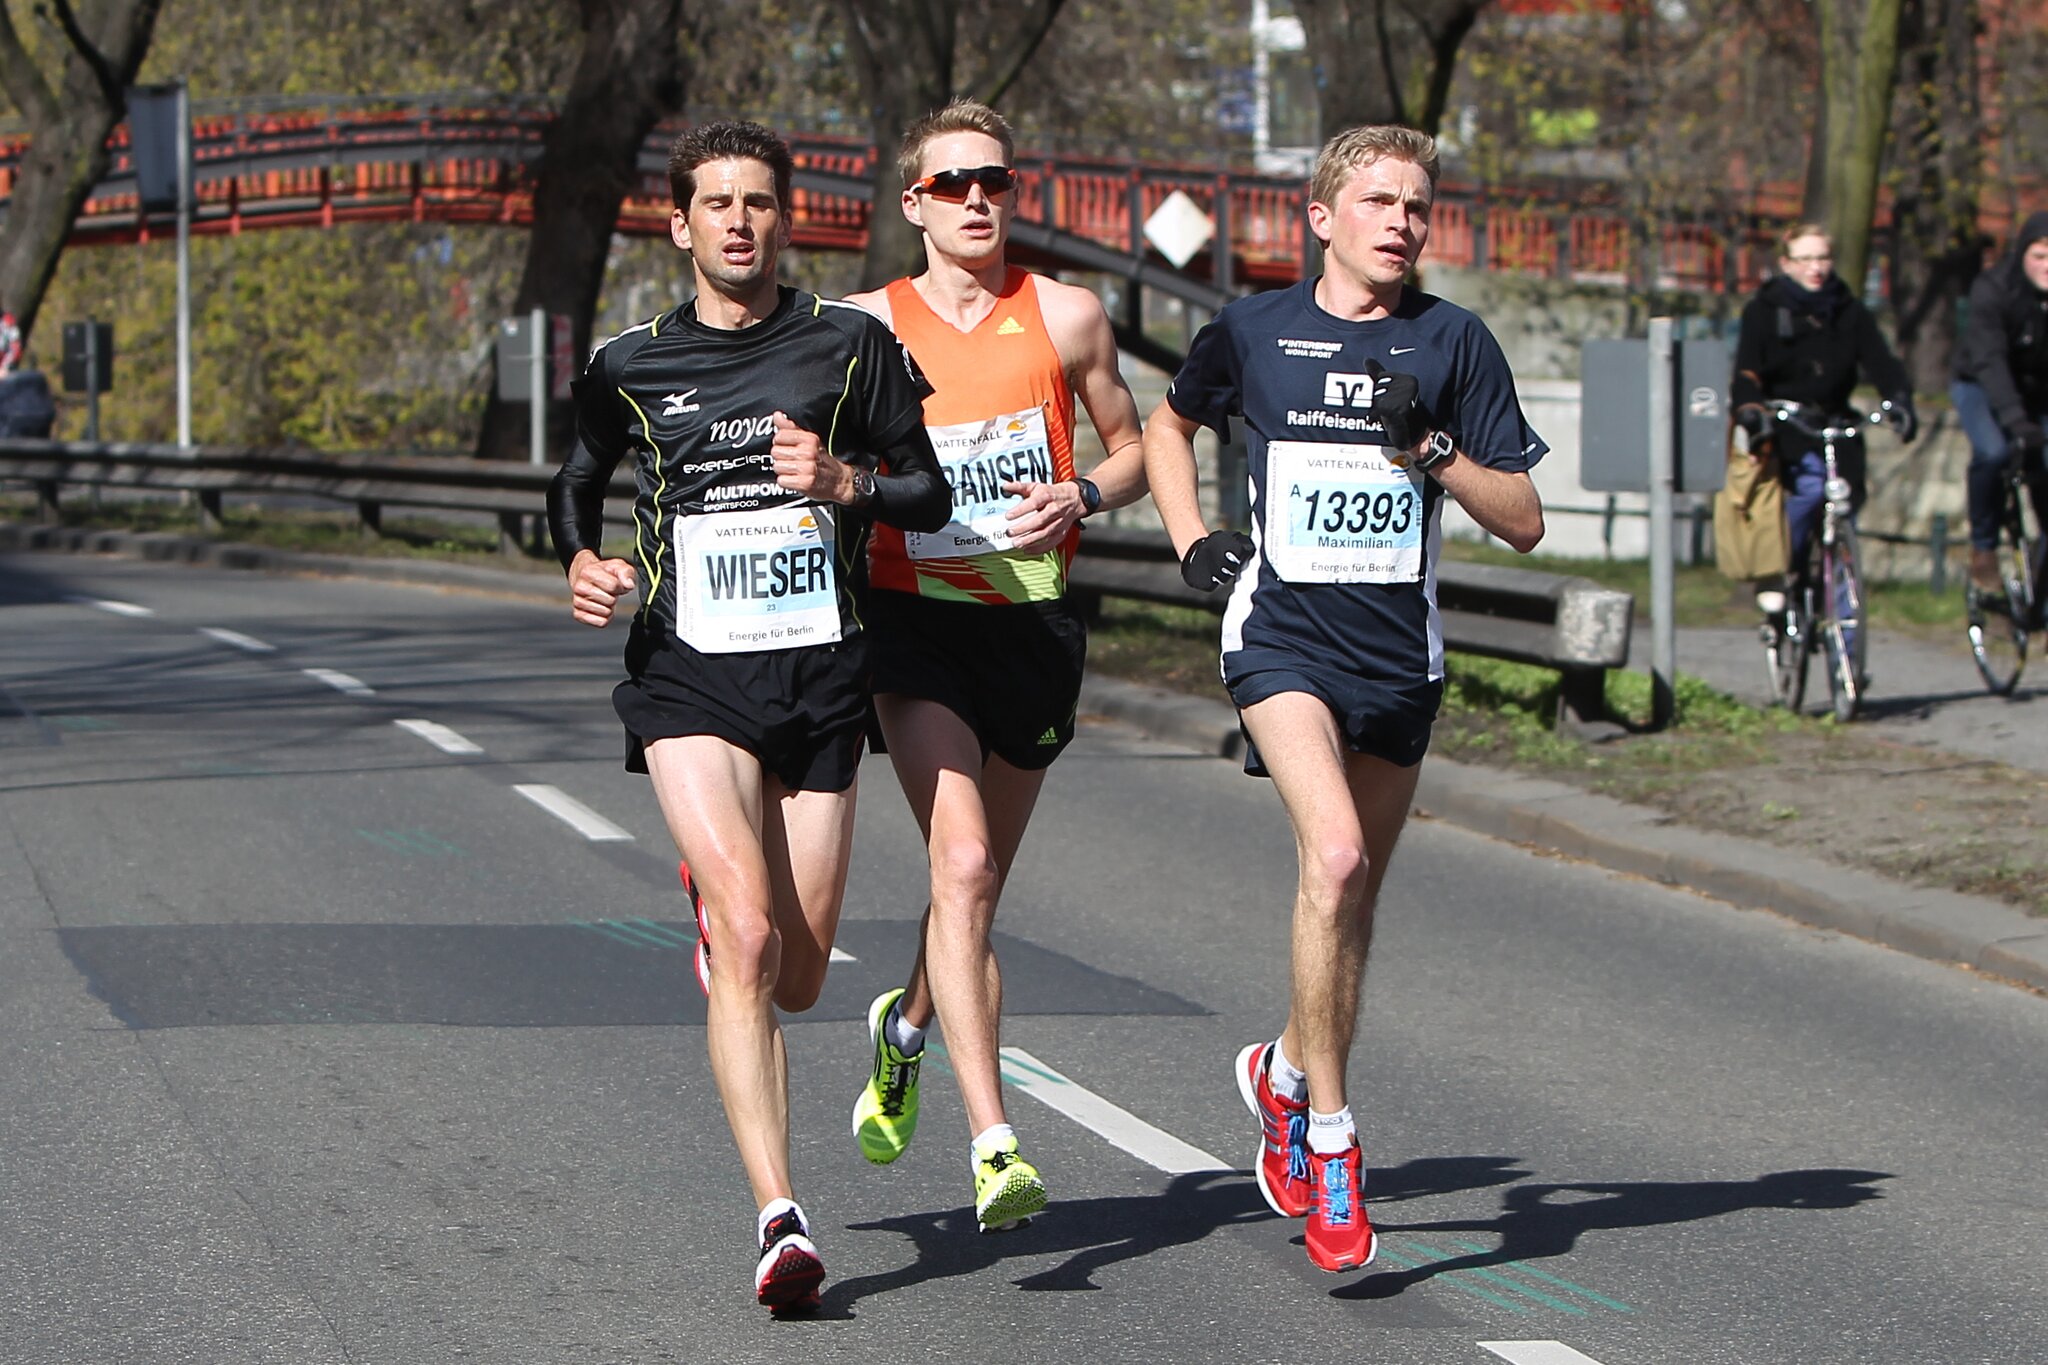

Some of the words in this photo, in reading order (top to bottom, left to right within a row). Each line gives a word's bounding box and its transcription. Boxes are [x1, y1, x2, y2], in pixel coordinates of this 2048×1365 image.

[709, 413, 788, 448] noya
[934, 430, 1003, 448] VATTENFALL
[682, 454, 776, 474] exerscien
[1306, 459, 1385, 471] VATTENFALL
[703, 482, 798, 502] MULTIPOW
[703, 499, 759, 512] SPORTSFOOD
[986, 507, 997, 515] 22
[1290, 484, 1301, 498] A
[1305, 489, 1414, 534] 13393
[715, 525, 794, 538] VATTENFALL
[953, 533, 990, 546] Energie
[1318, 535, 1393, 549] Maximilian
[705, 546, 828, 601] WIESER
[1311, 561, 1349, 574] Energie
[1352, 563, 1366, 573] für
[1368, 562, 1396, 573] Berlin
[765, 603, 777, 612] 23
[728, 631, 768, 642] Energie
[770, 628, 784, 639] für
[787, 625, 815, 637] Berlin
